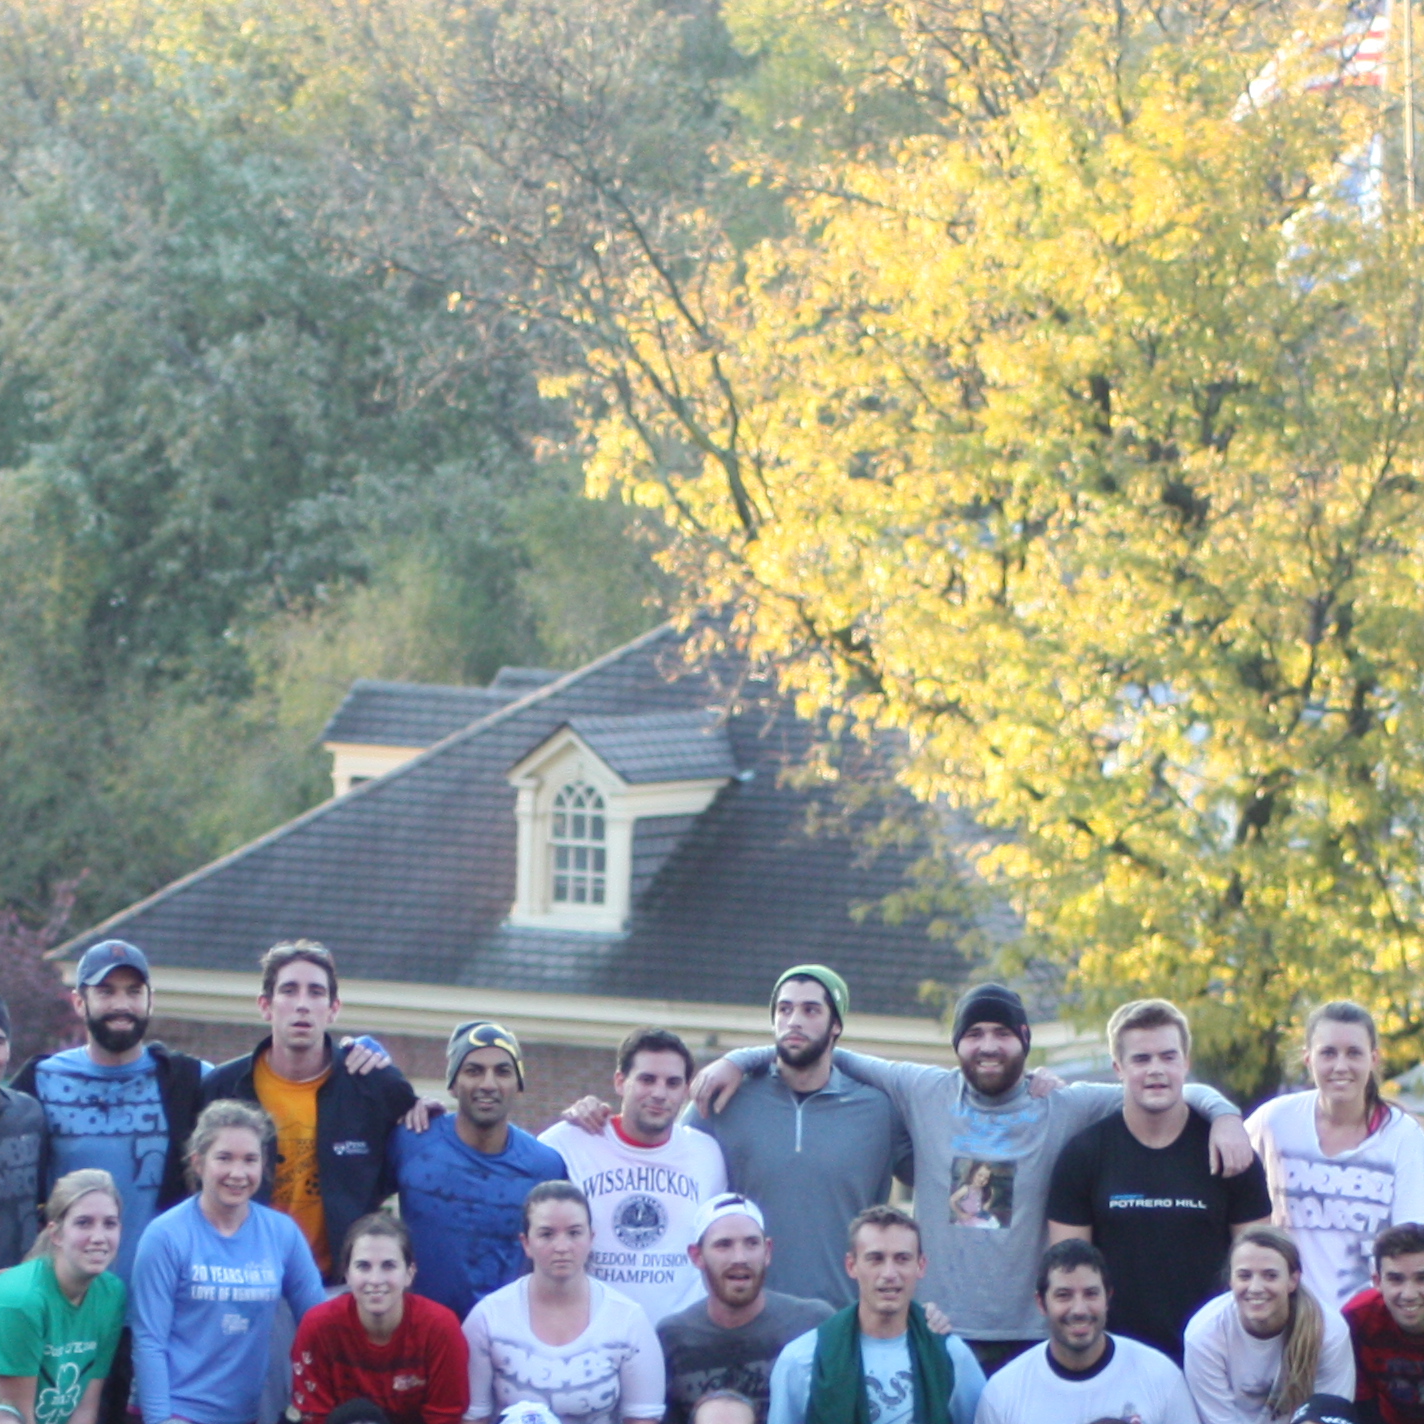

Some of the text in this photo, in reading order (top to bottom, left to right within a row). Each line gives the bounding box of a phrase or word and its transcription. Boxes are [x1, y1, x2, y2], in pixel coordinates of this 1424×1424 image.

[582, 1167, 699, 1205] WISSAHICKON
[1109, 1198, 1207, 1210] POTRERO HILL
[642, 1253, 689, 1268] DIVISION
[191, 1264, 208, 1282] 20
[209, 1265, 245, 1284] YEARS
[191, 1285, 217, 1301] LOVE
[218, 1286, 231, 1301] OF
